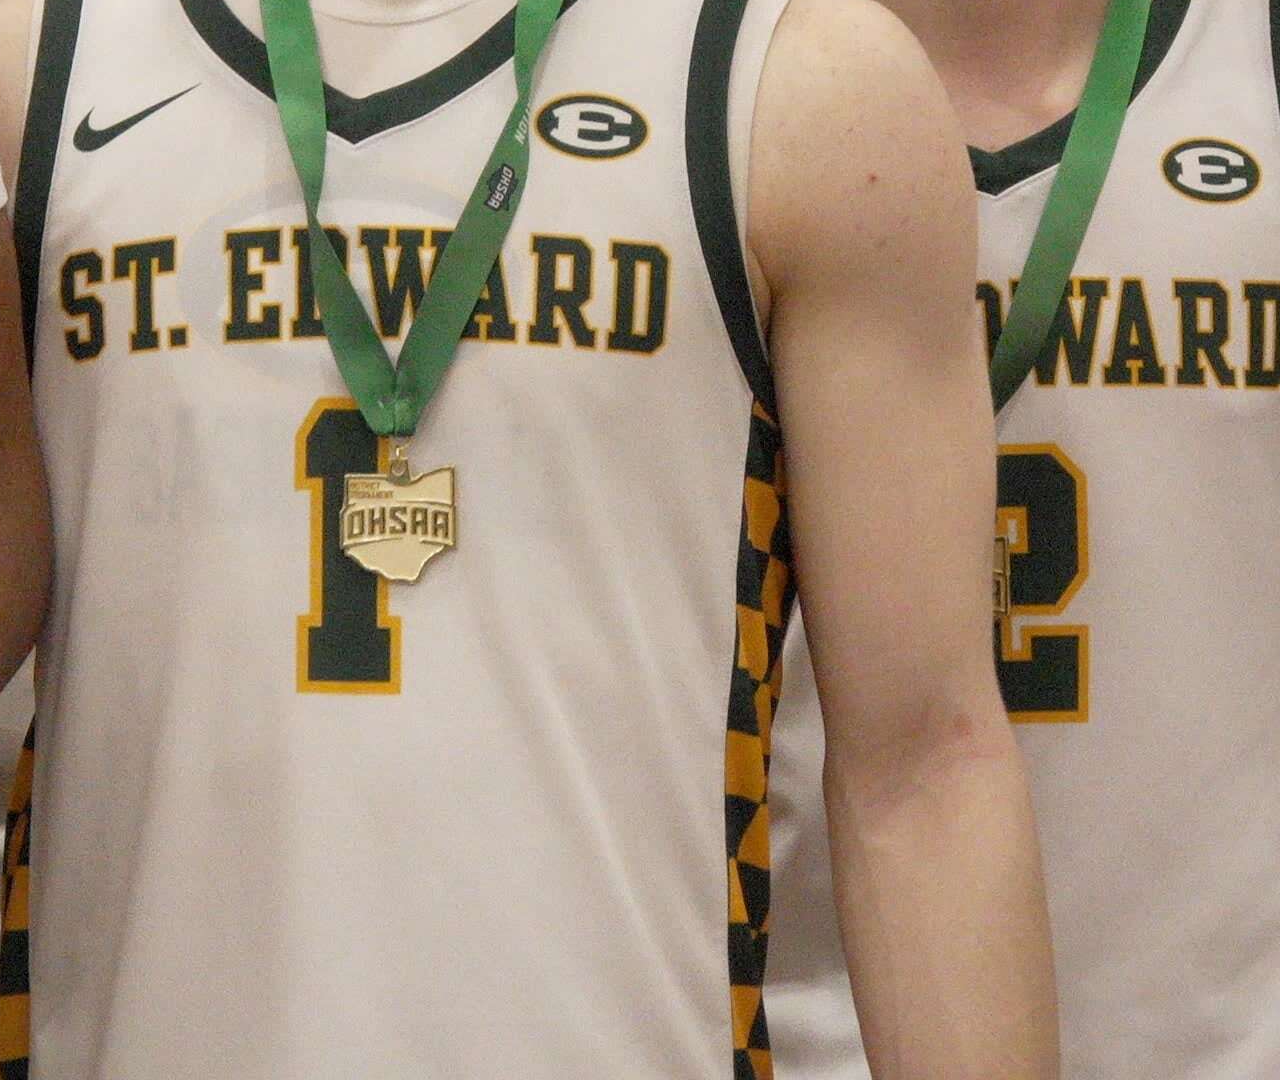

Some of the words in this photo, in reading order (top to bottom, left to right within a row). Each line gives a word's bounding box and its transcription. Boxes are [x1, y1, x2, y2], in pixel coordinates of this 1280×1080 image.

[486, 166, 513, 209] OHSAA
[59, 234, 190, 364] ST.
[294, 396, 403, 695] 1
[347, 506, 449, 541] OHSAA
